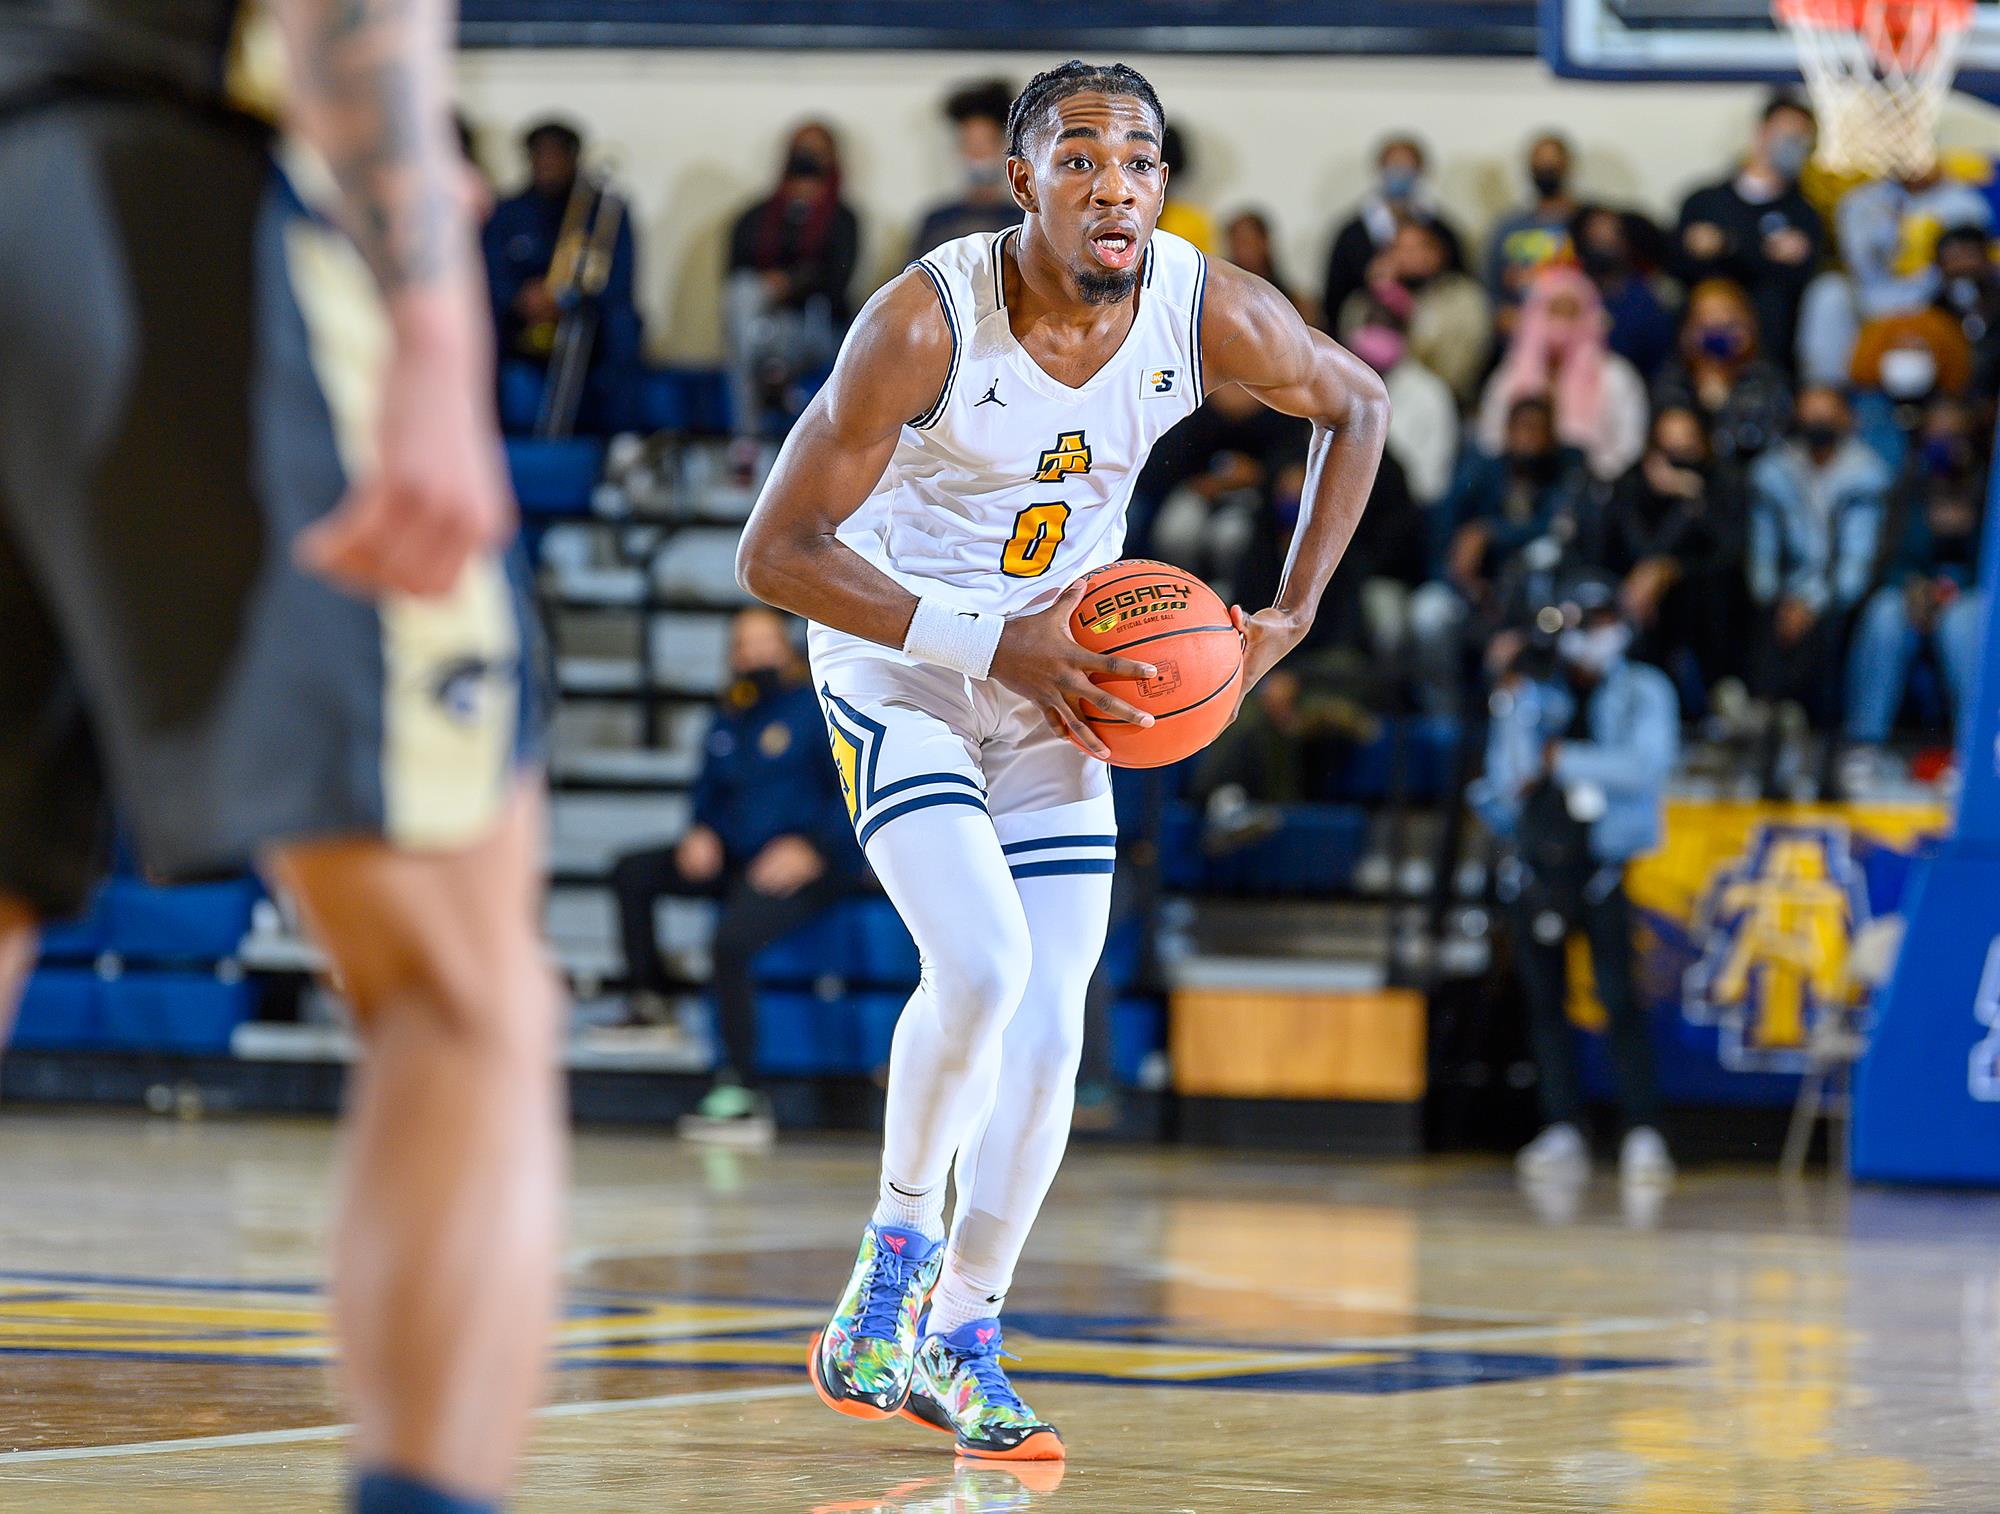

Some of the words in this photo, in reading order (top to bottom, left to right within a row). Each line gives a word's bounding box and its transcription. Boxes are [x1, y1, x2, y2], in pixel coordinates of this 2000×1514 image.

[1000, 501, 1072, 578] 0
[1078, 584, 1192, 627] LEGACY
[1119, 601, 1188, 621] 1000
[1116, 620, 1143, 633] OFFICIAL
[1143, 615, 1160, 624] GAME
[1160, 613, 1175, 621] BALL
